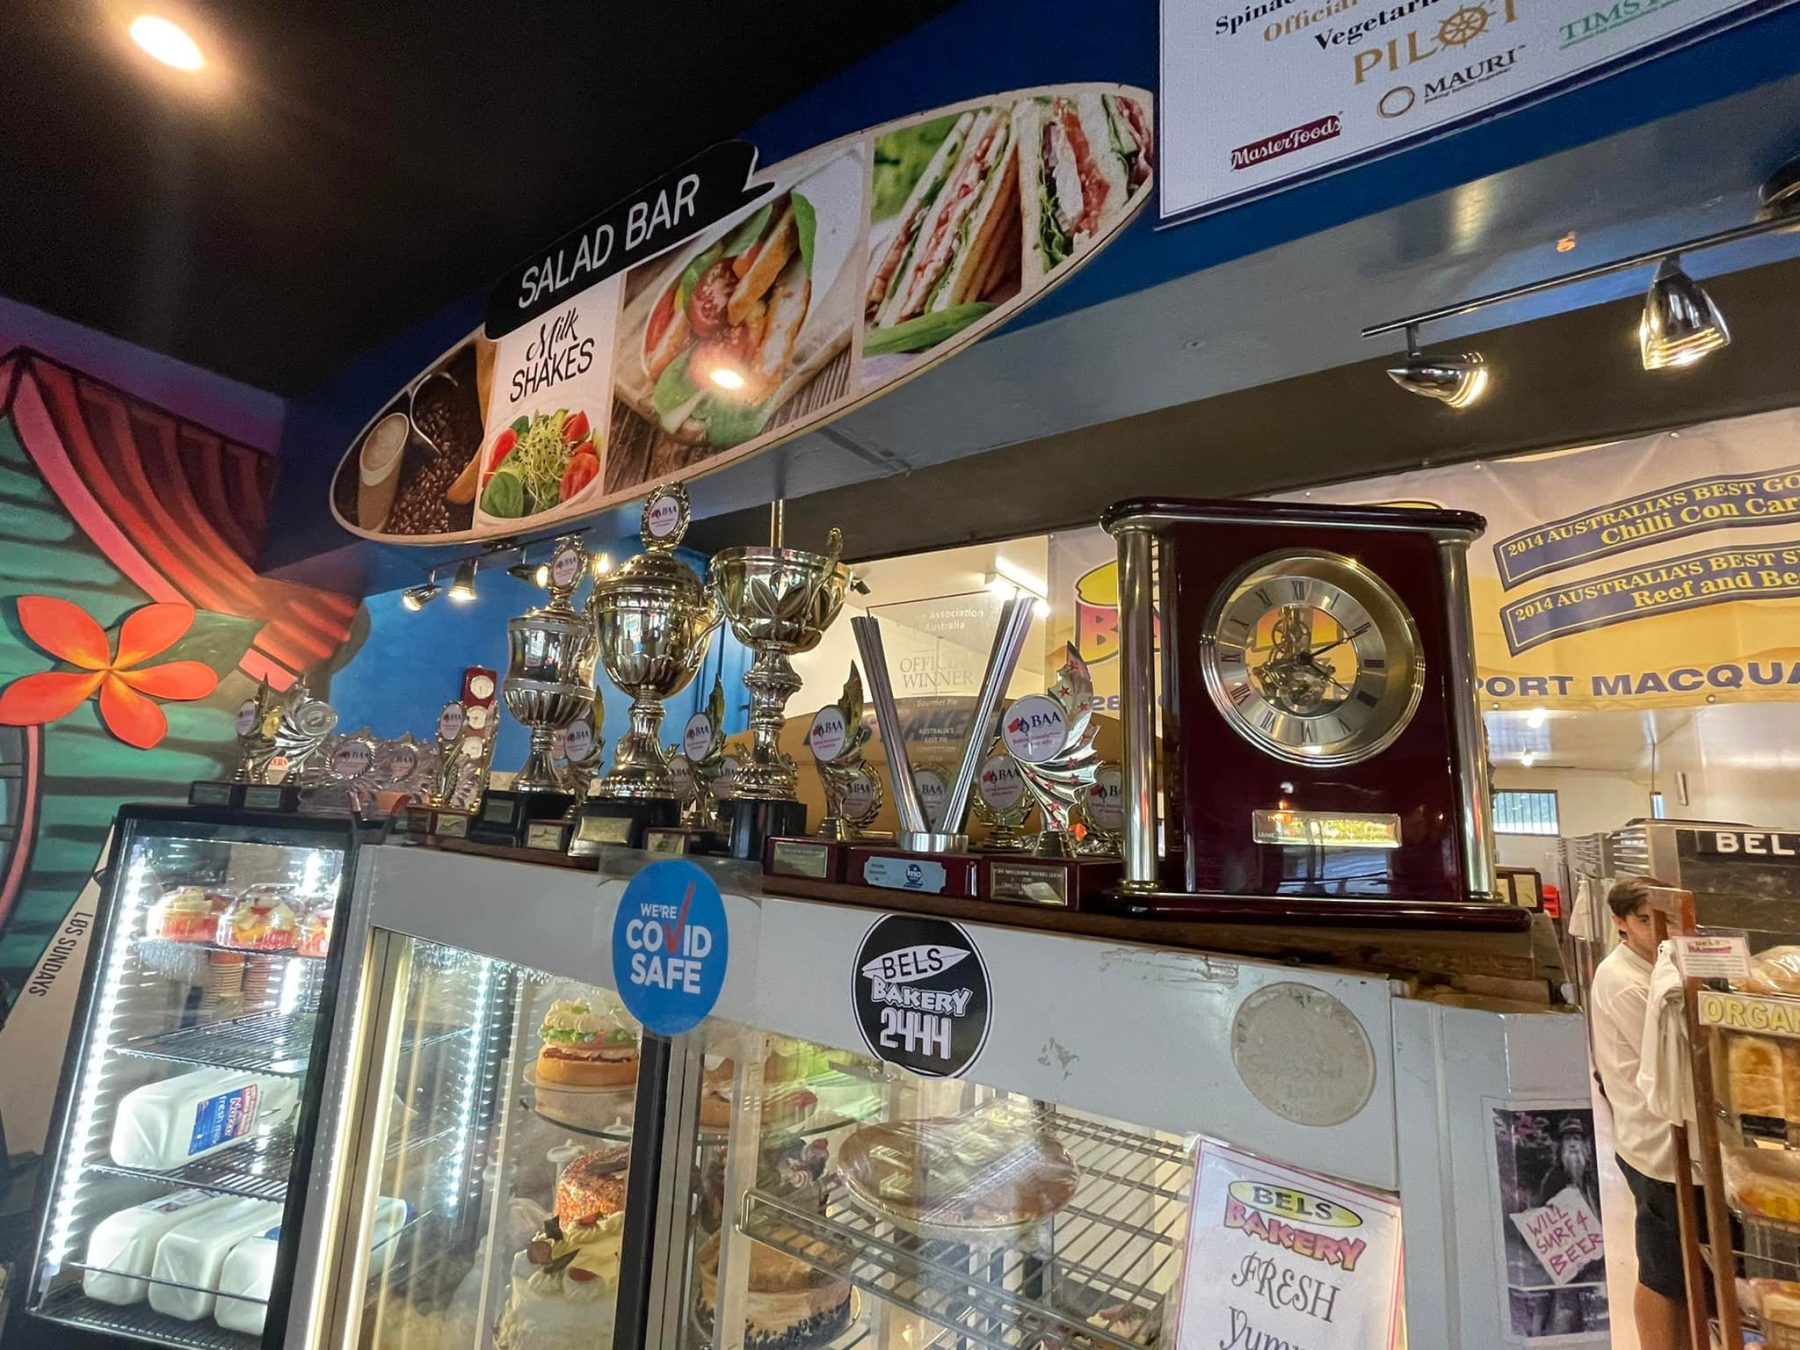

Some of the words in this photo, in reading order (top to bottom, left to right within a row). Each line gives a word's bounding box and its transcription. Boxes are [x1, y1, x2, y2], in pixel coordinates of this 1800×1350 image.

[1215, 0, 1298, 35] Spina
[1424, 48, 1518, 98] MAURI
[1231, 115, 1343, 171] MasterFoods
[518, 223, 615, 309] SALAD
[625, 173, 700, 251] BAR
[526, 307, 579, 362] Milk
[510, 337, 595, 402] SHAKES
[1508, 536, 1543, 558] 2014
[1546, 493, 1688, 544] AUSTRALIA'S
[1693, 482, 1757, 500] BEST
[1601, 513, 1675, 546] Chilli
[1680, 501, 1739, 525] Con
[1515, 597, 1553, 622] 2014
[1557, 560, 1704, 607] AUSTRALIA'S
[1708, 552, 1775, 572] BEST
[1631, 580, 1695, 609] Reef
[1700, 571, 1754, 594] and
[903, 669, 974, 688] WINNER
[1031, 711, 1061, 728] BAA
[640, 902, 678, 919] WE'RE
[626, 919, 712, 958] COVID
[28, 937, 77, 997] SUNDAYS
[630, 953, 702, 994] SAFE
[882, 947, 944, 980] BELS
[871, 974, 975, 1017] BAKERY
[880, 1005, 953, 1060] 2444
[1252, 1186, 1333, 1219] BELS
[1526, 1206, 1568, 1237] WILL
[1224, 1194, 1367, 1272] BAKERY
[1536, 1218, 1577, 1254] SURF
[1577, 1210, 1588, 1232] 4
[1549, 1232, 1604, 1276] BEER
[1231, 1251, 1341, 1323] FRESH
